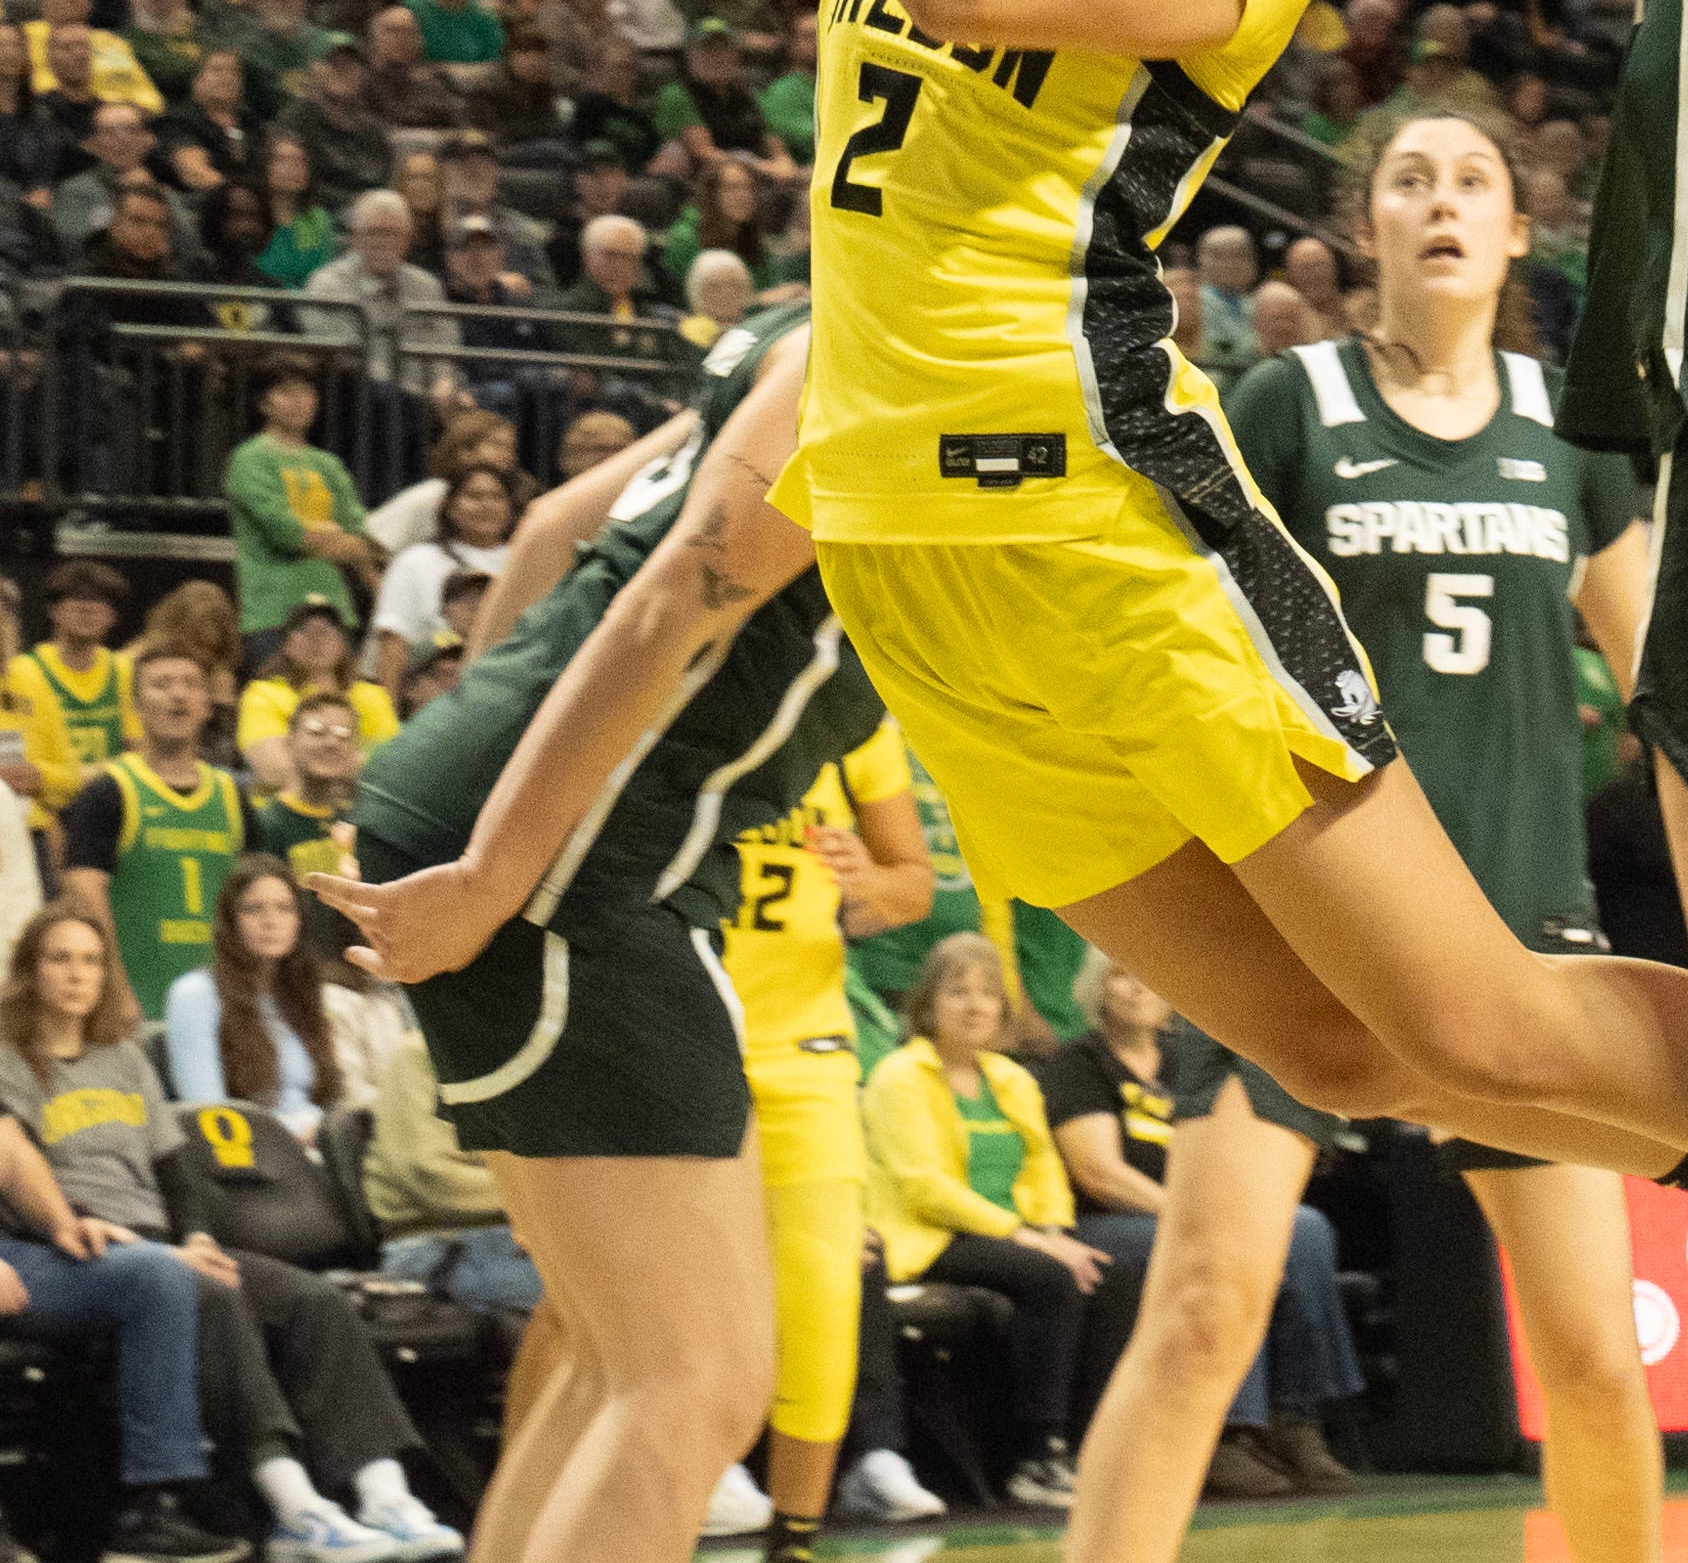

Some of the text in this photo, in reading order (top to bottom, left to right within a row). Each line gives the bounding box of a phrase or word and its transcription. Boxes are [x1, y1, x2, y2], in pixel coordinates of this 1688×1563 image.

[830, 61, 924, 218] 2
[1325, 501, 1570, 563] SPARTANS
[1422, 572, 1495, 676] 5
